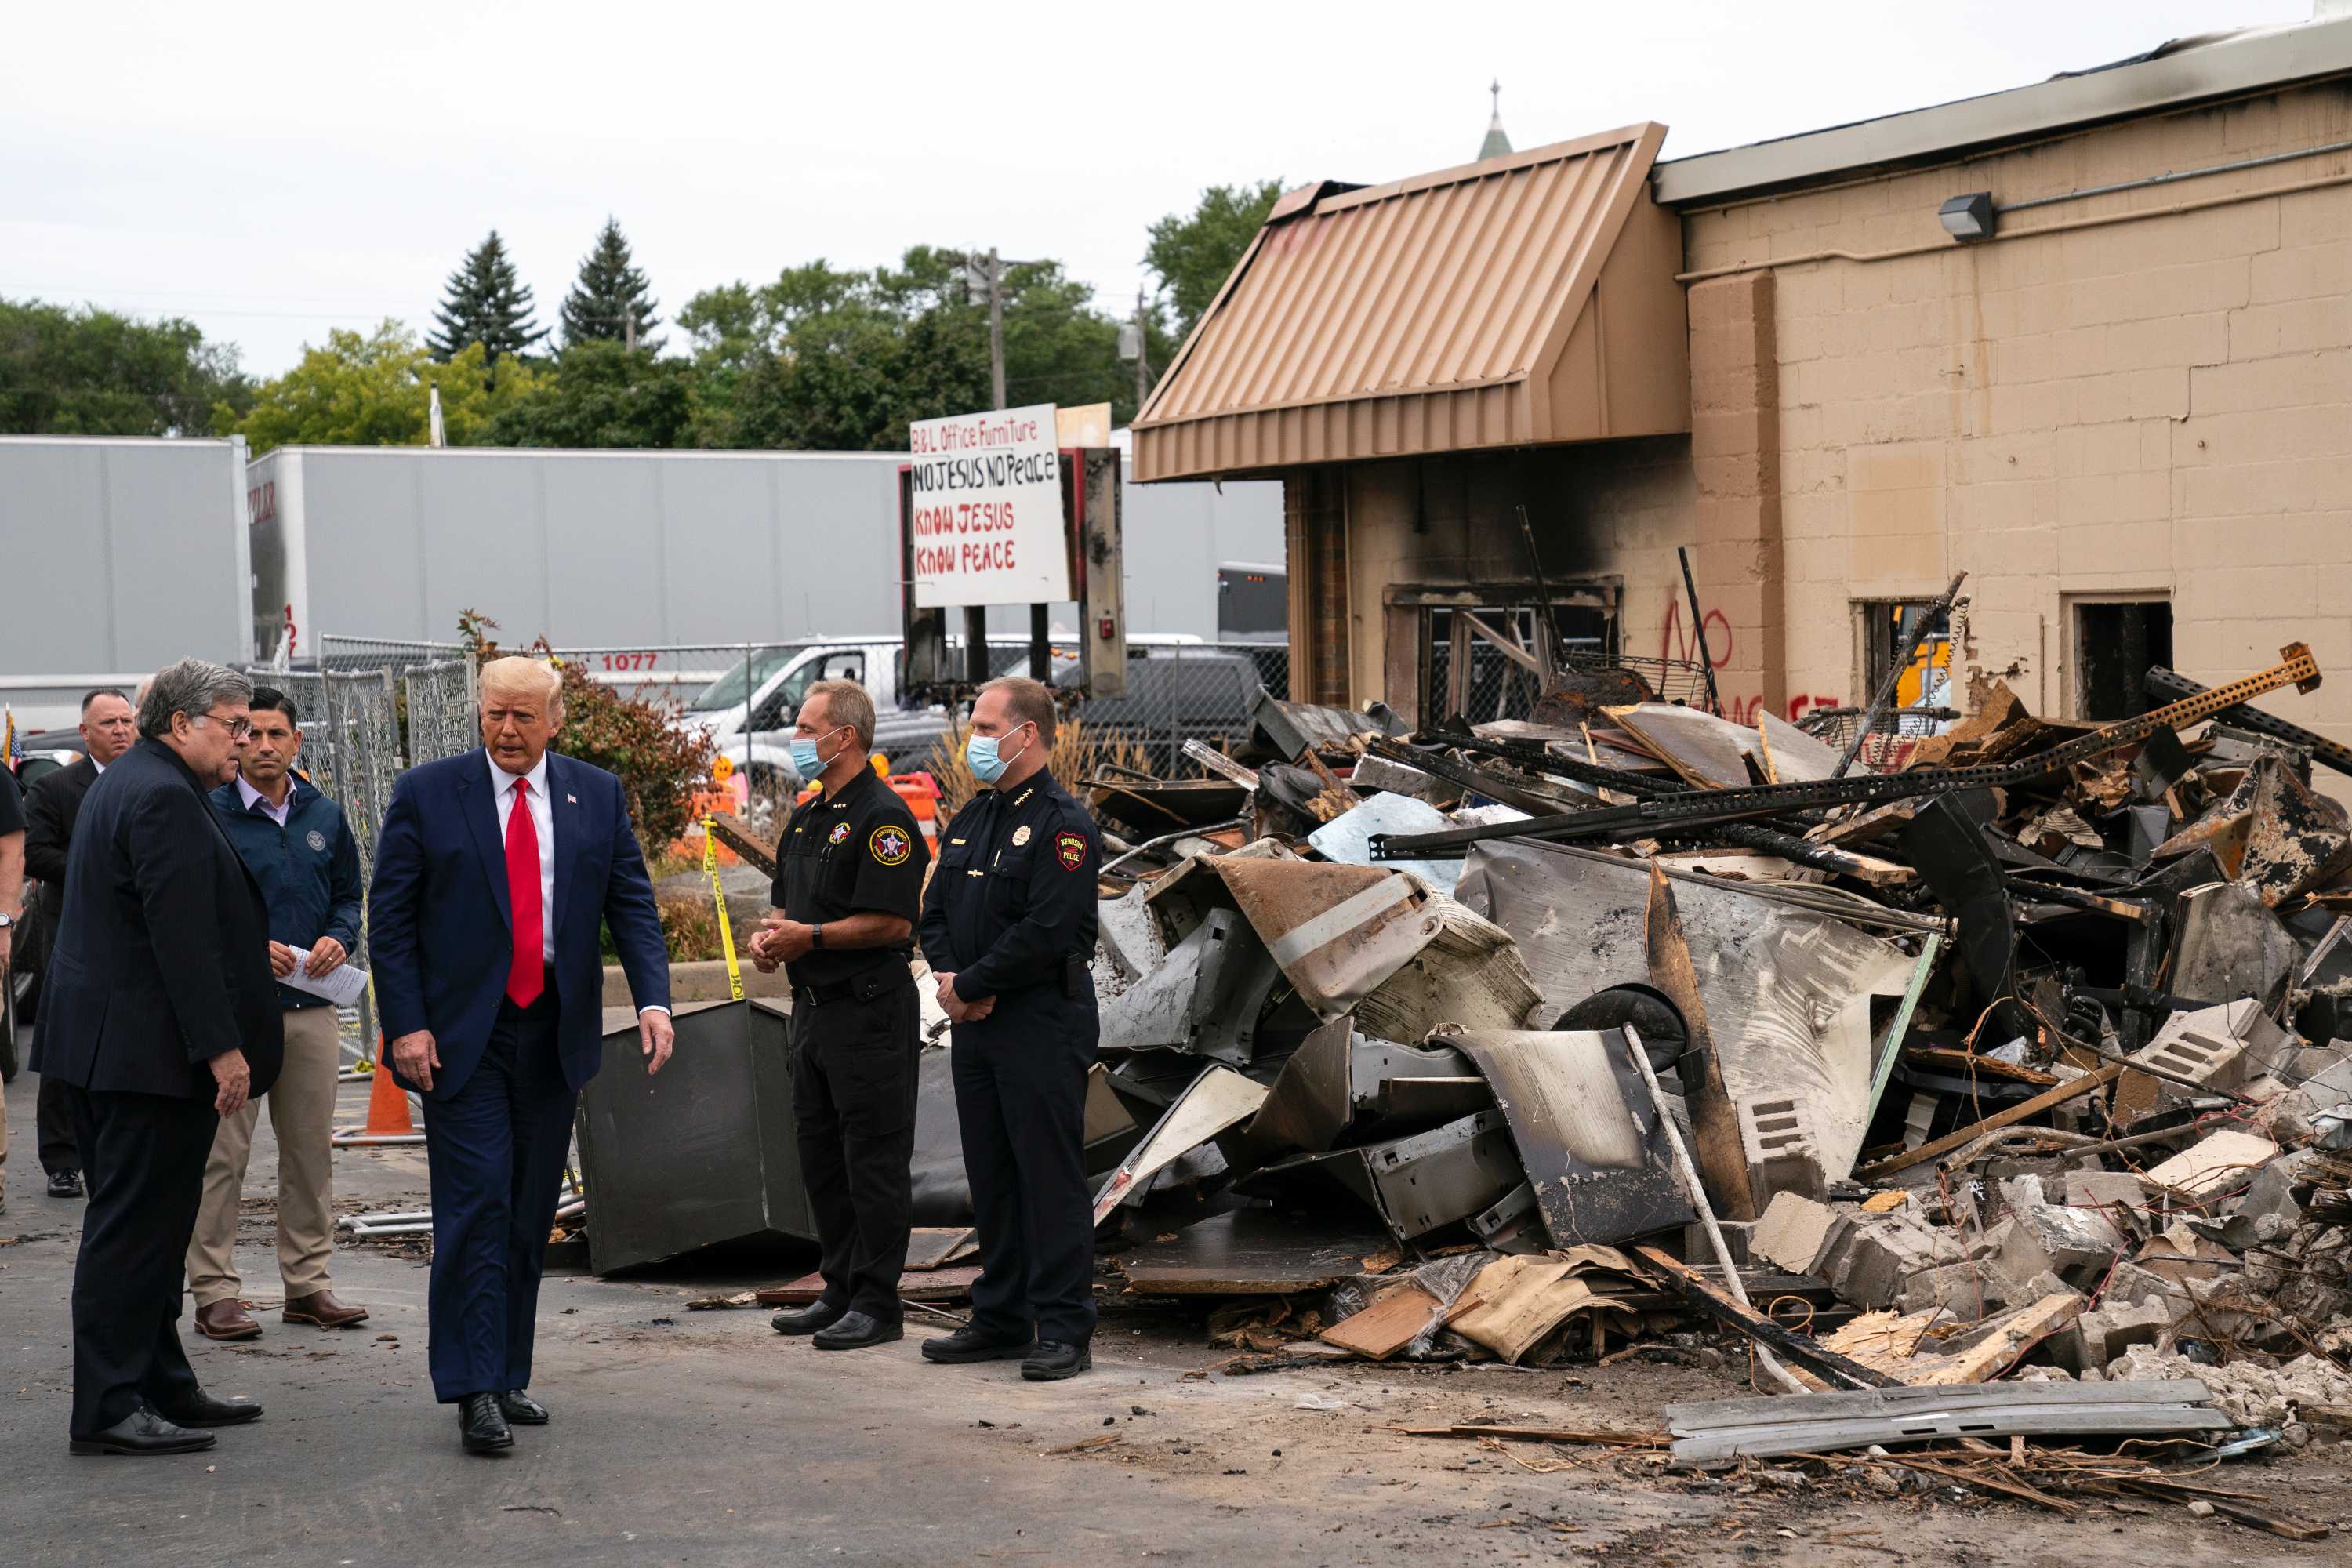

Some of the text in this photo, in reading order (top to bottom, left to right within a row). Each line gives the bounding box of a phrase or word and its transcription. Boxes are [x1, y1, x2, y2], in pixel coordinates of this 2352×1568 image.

[912, 417, 1037, 453] B&L Office Furniture
[913, 452, 1054, 492] NO JESUS NO Peace
[957, 501, 1014, 534] JESUS
[962, 539, 1016, 574] PEACE
[1661, 599, 1733, 673] NO
[601, 652, 658, 671] 1077
[1060, 838, 1083, 851] KENOSHA
[1063, 851, 1080, 862] POLICE
